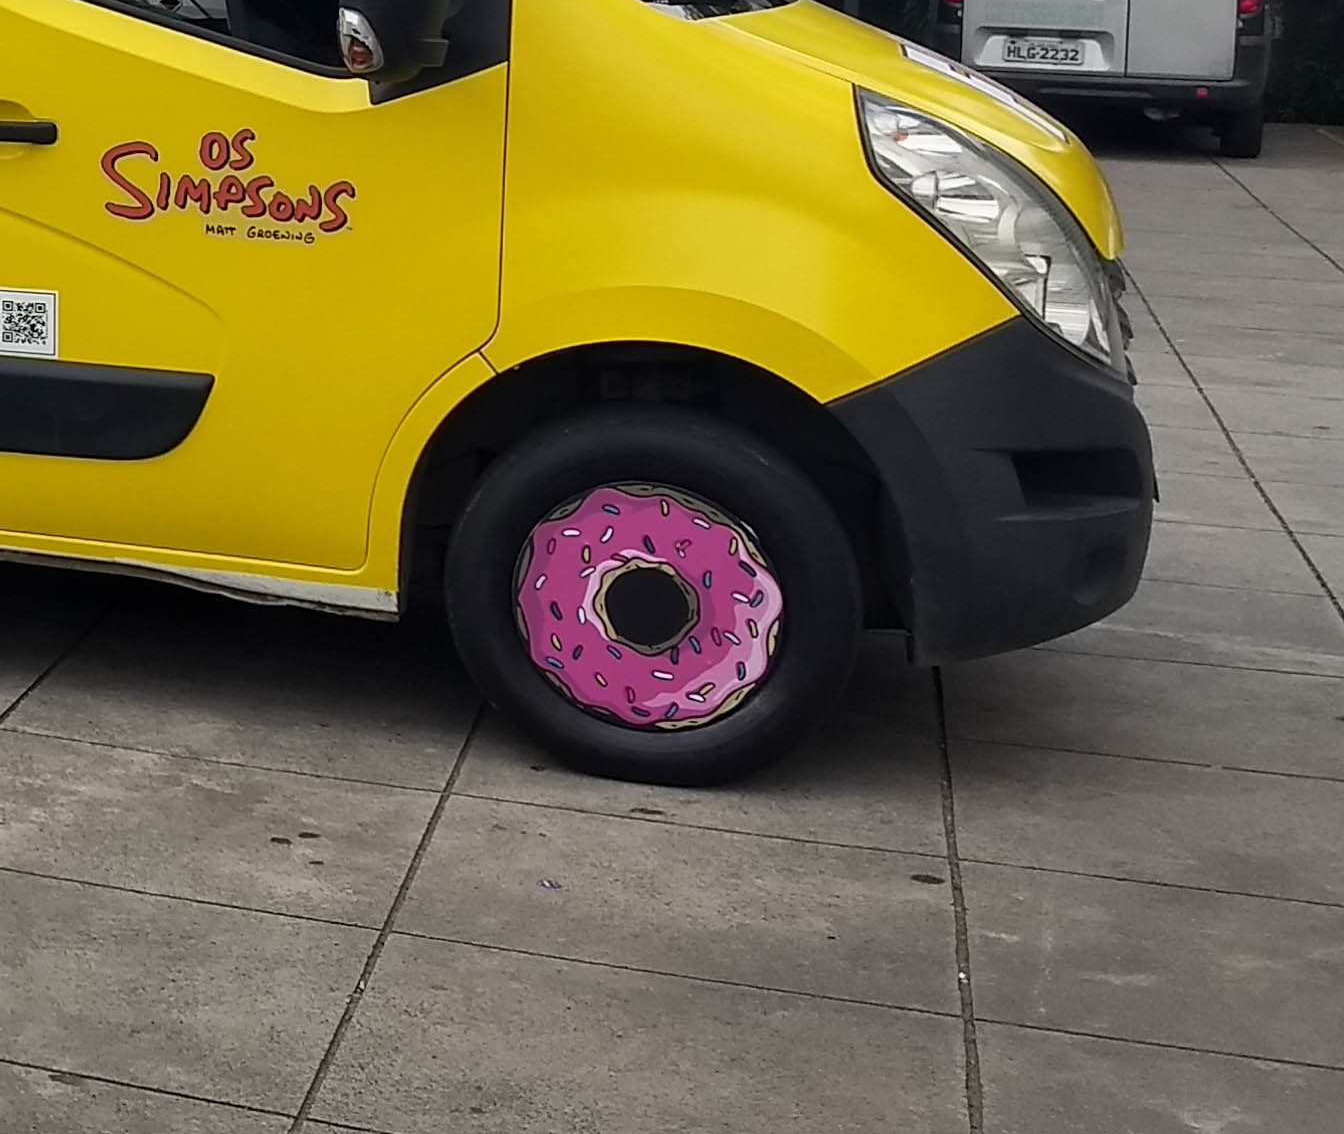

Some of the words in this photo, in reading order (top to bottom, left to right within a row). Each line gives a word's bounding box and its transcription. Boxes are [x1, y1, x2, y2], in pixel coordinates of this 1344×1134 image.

[199, 128, 255, 171] OS
[100, 140, 356, 233] SIMPSONS
[205, 223, 236, 236] MATT
[247, 225, 315, 244] GROENING
